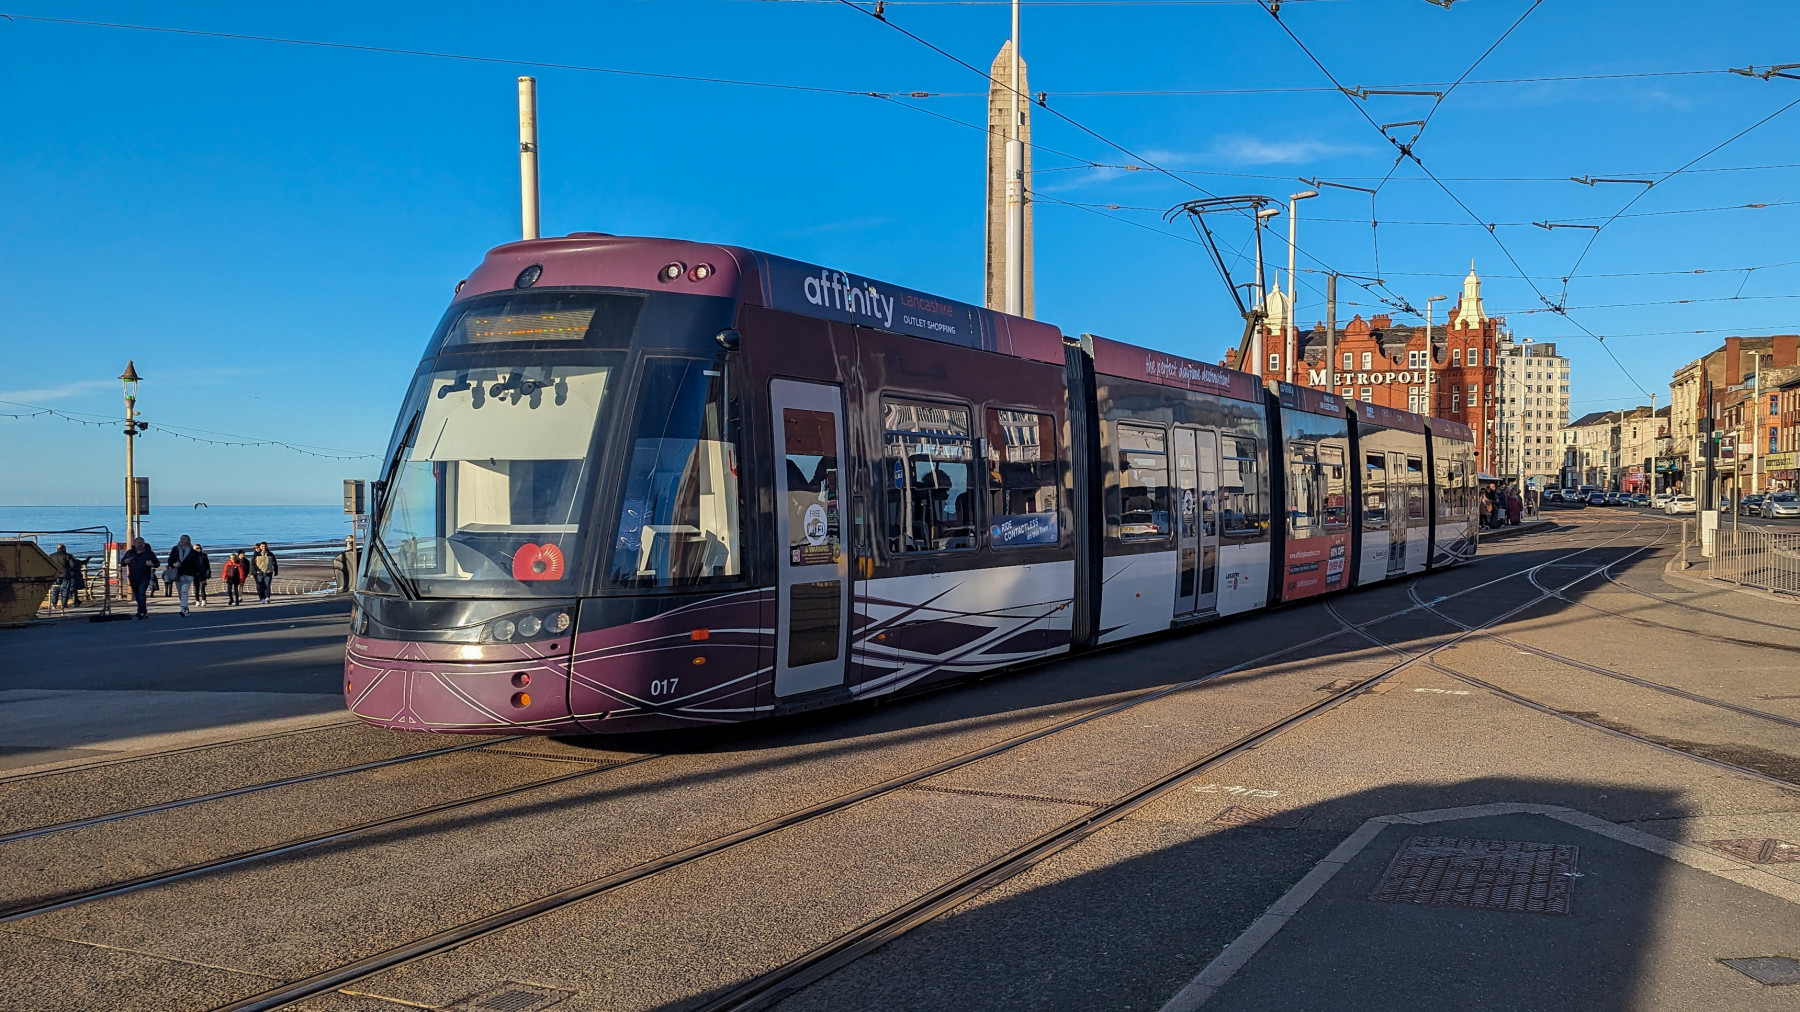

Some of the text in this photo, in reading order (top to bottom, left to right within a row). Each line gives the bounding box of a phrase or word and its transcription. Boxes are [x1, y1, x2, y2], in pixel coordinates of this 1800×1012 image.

[804, 269, 894, 328] affinity
[900, 290, 953, 317] Lancashire
[903, 315, 956, 335] OUTLET SHOPPING
[1308, 369, 1437, 386] METROPOLE
[1001, 520, 1012, 532] RIDE
[1004, 517, 1039, 541] CONTACTLESS
[651, 678, 679, 696] 017
